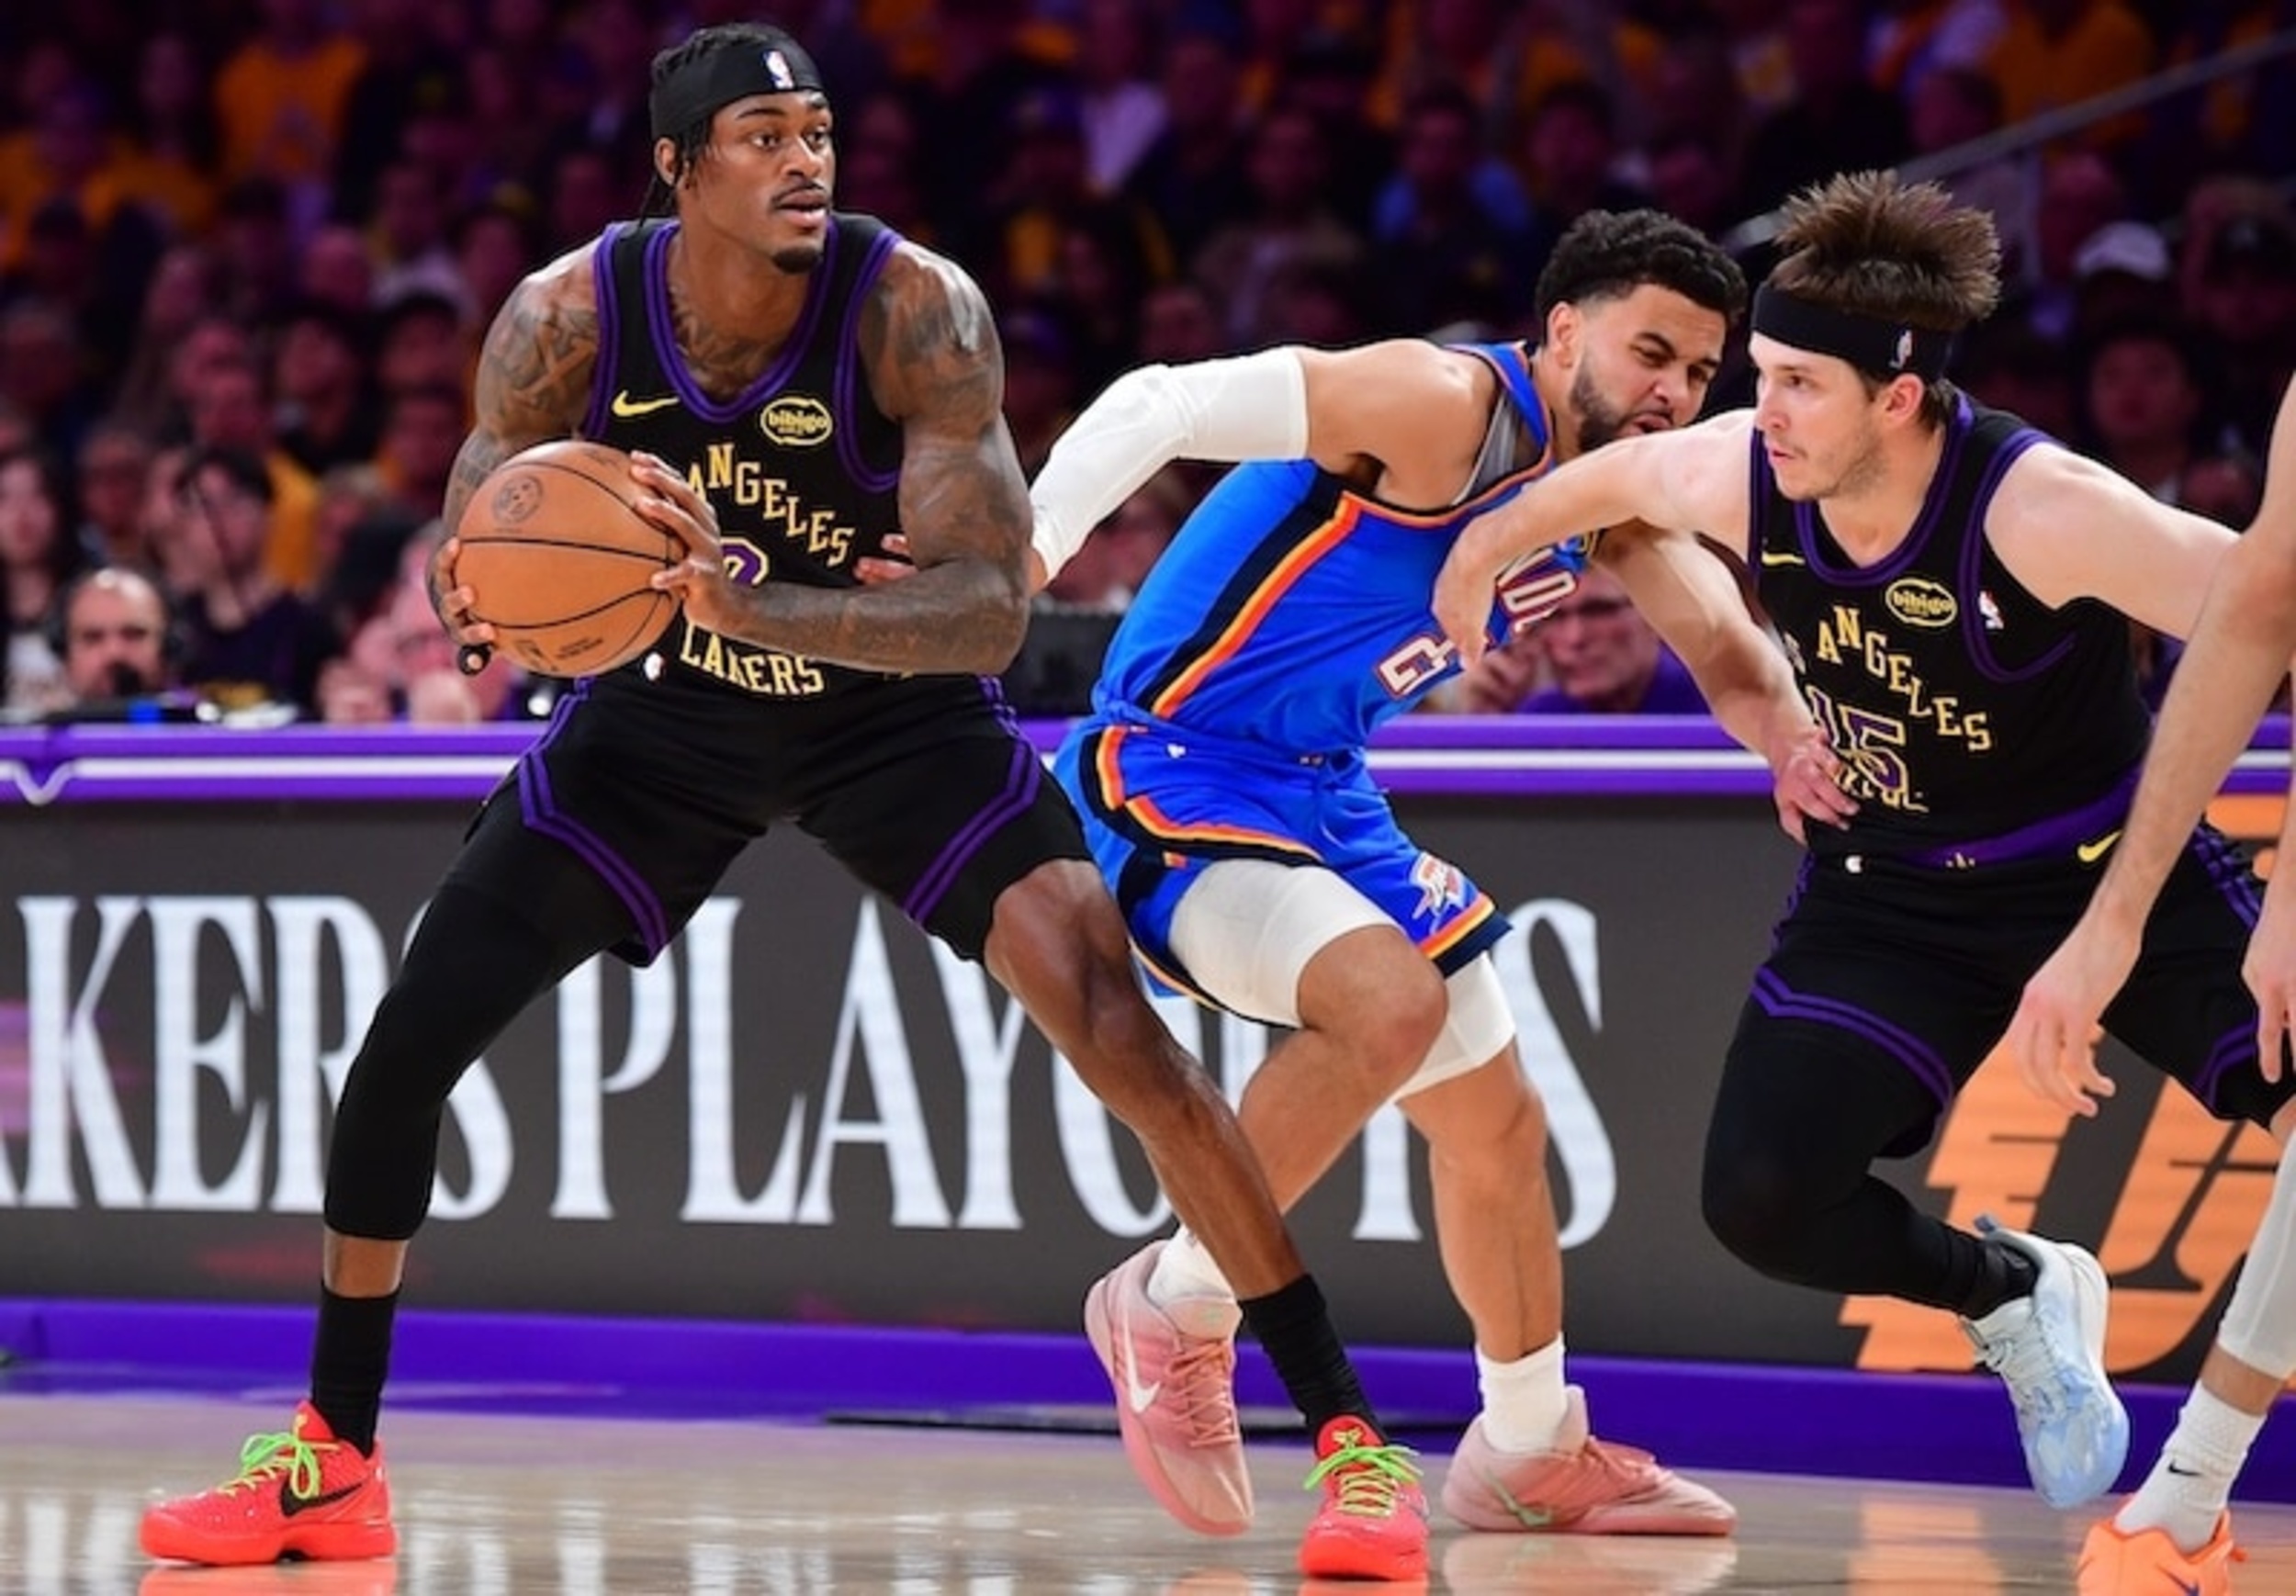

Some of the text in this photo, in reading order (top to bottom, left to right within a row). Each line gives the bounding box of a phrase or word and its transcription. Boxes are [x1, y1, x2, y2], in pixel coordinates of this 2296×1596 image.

[768, 410, 829, 434] bibigo
[688, 443, 855, 567] ANGELES
[1893, 590, 1954, 615] bibigo
[1816, 605, 1992, 751] ANGELES
[0, 894, 515, 1220] KERS
